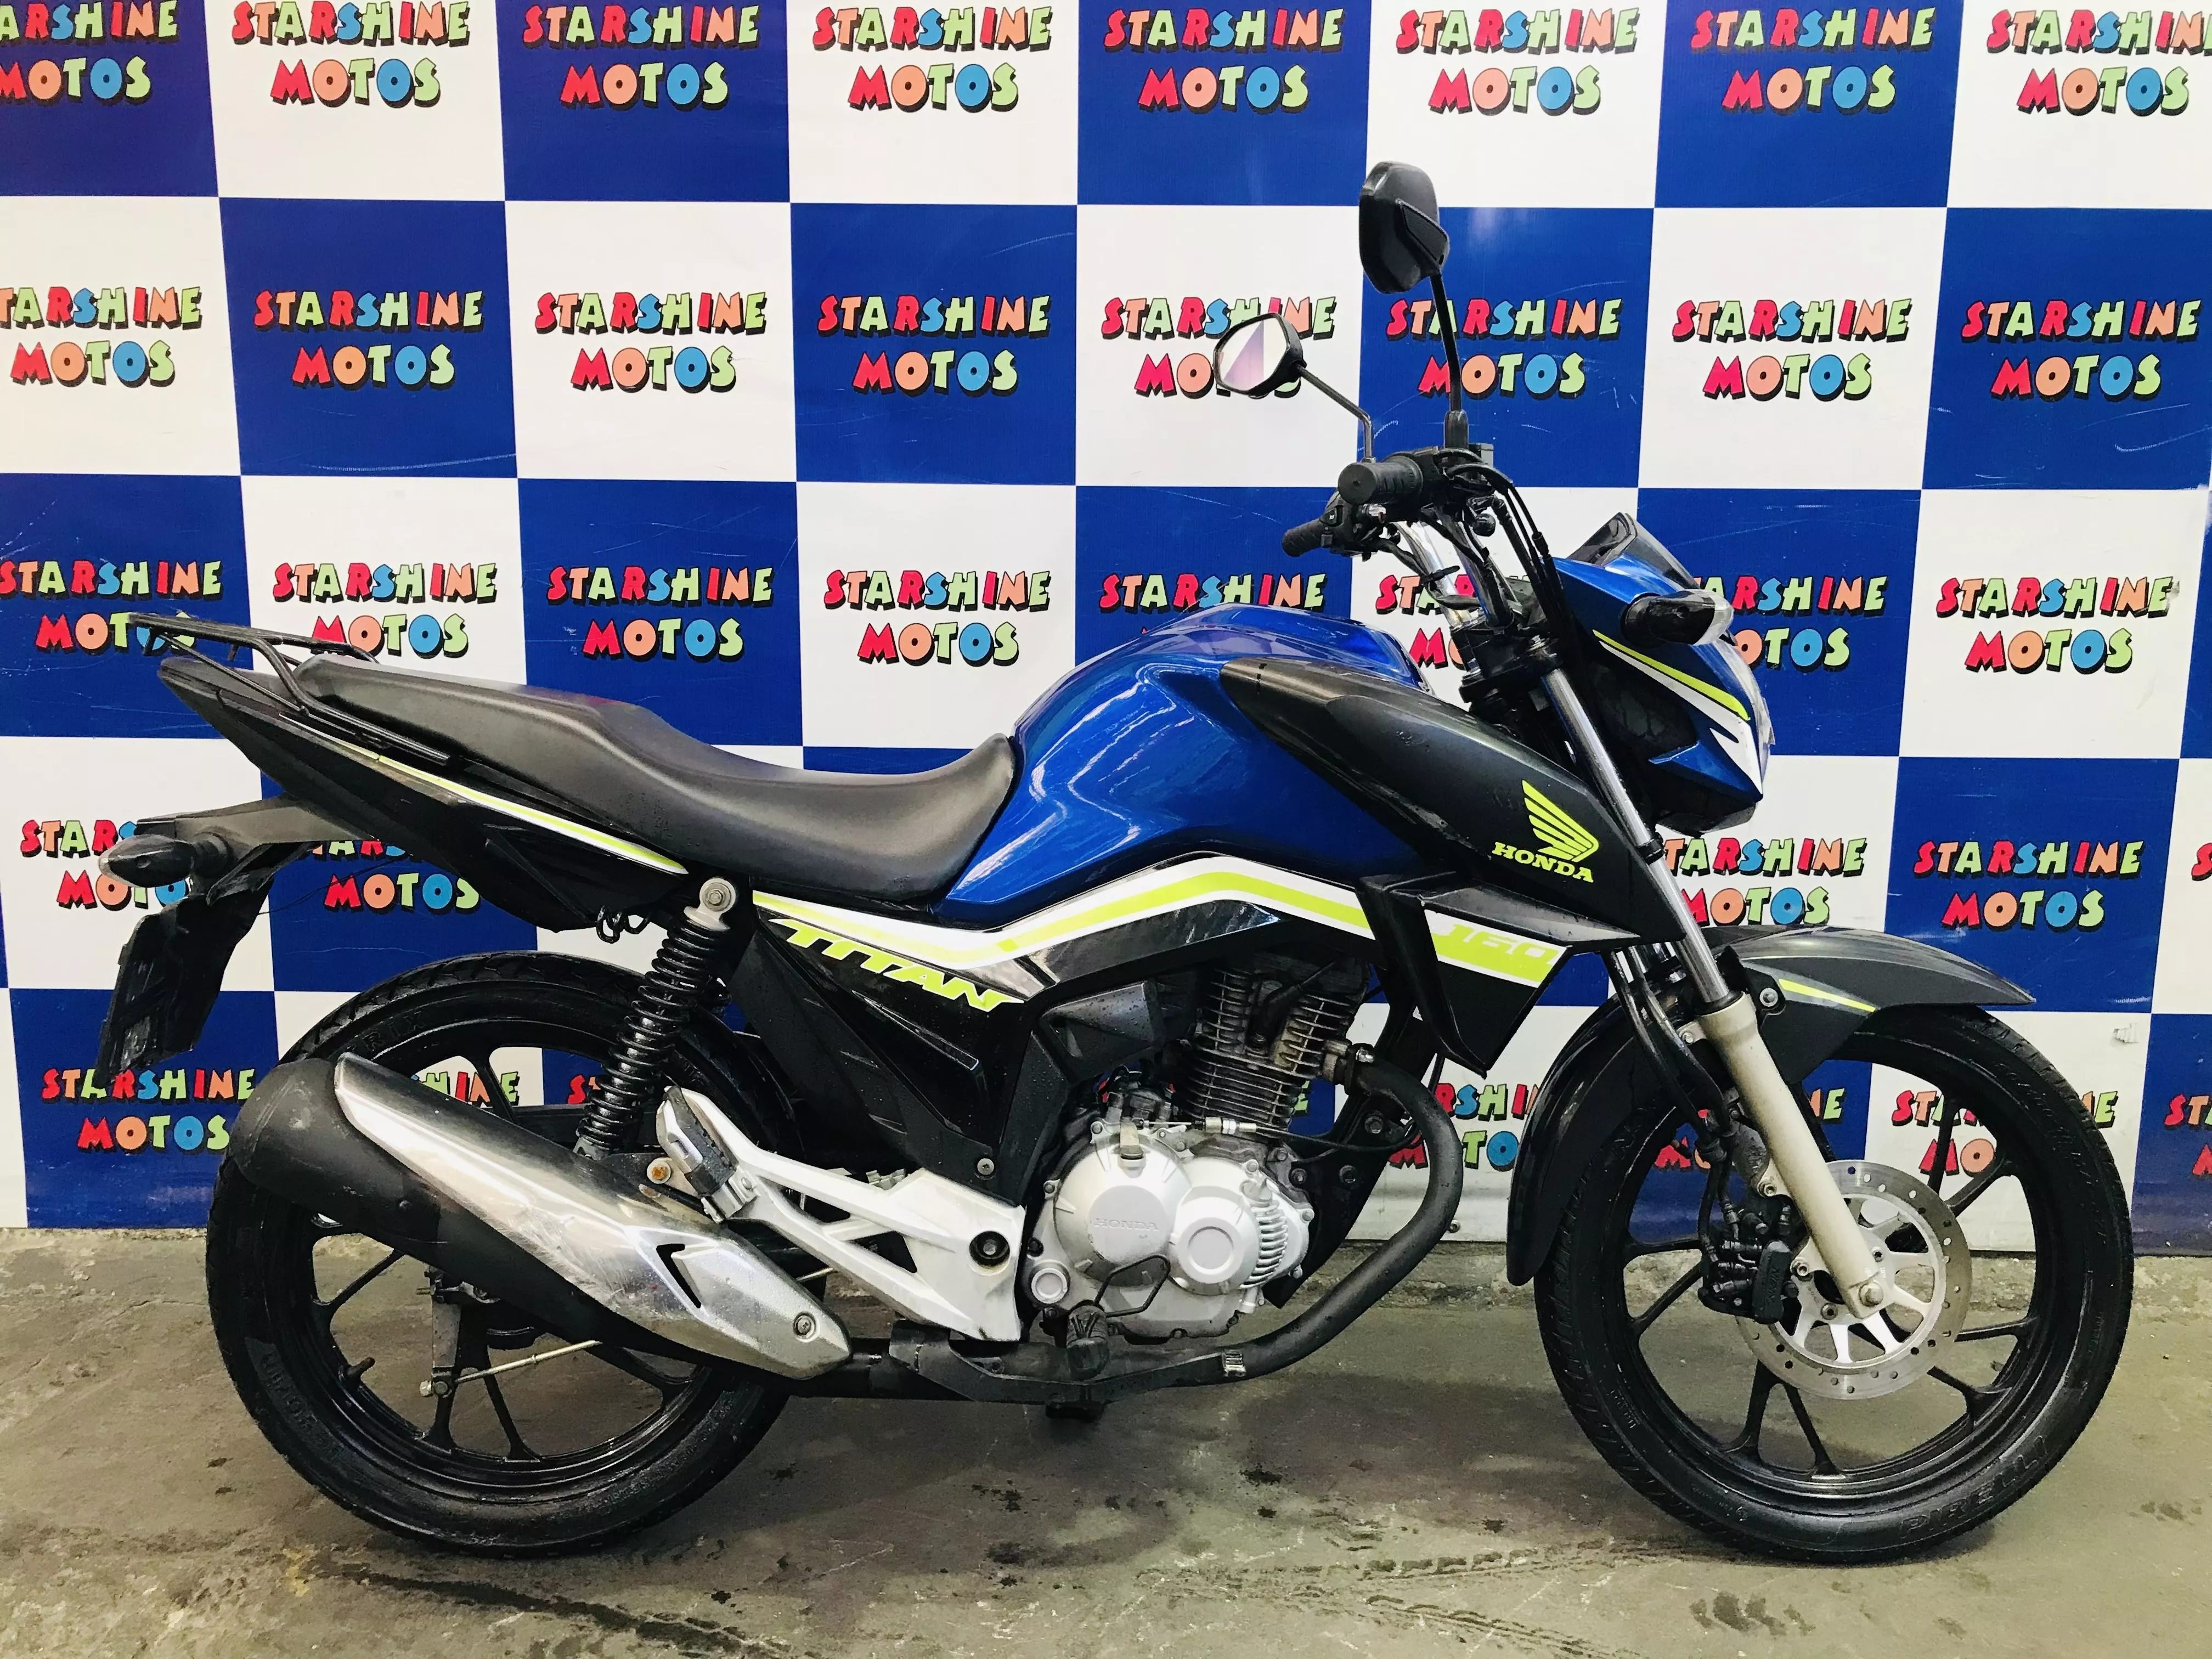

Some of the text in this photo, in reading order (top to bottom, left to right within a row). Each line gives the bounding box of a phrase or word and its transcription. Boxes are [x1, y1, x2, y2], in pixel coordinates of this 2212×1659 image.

[0, 0, 178, 43] ARSHINE
[232, 0, 469, 44] STARSHINE
[523, 4, 759, 47] STARSHINE
[812, 7, 1051, 50] STARSHINE
[1104, 8, 1342, 51] STARSHINE
[1396, 7, 1640, 54] STARSHINE
[1691, 8, 1934, 52] STARSHINE
[0, 56, 151, 104] MOTOS
[270, 58, 441, 105] MOTOS
[560, 63, 728, 109] MOTOS
[848, 63, 1019, 110] MOTOS
[1138, 65, 1308, 112] MOTOS
[1429, 67, 1600, 112] MOTOS
[1722, 65, 1896, 113] MOTOS
[2017, 66, 2191, 114] MOTOS
[0, 285, 201, 328] TARSHINE
[253, 290, 482, 330] STARSHINE
[534, 291, 766, 333] STARSHINE
[817, 295, 1049, 336] STARSHINE
[1672, 299, 1912, 341] STARSHINE
[1961, 300, 2199, 341] STARSHINE
[10, 340, 176, 385] MOTOS
[291, 345, 454, 388] MOTOS
[571, 346, 736, 391] MOTOS
[853, 350, 1018, 396] MOTOS
[1419, 353, 1586, 398] MOTOS
[1703, 353, 1872, 399] MOTOS
[1991, 354, 2162, 400] MOTOS
[0, 560, 222, 599] STARSHINE
[272, 562, 496, 602] STARSHINE
[547, 566, 772, 605] STARSHINE
[823, 570, 1048, 609] STARSHINE
[1099, 573, 1326, 613] STARSHINE
[1692, 576, 1888, 617] ARSHINE
[1936, 577, 2171, 617] STARSHINE
[312, 614, 469, 657] MOTOS
[583, 618, 744, 661] MOTOS
[858, 622, 1019, 665] MOTOS
[1734, 627, 1850, 672] OTOS
[1965, 628, 2134, 673] MOTOS
[1492, 841, 1594, 883] HONDA
[1662, 838, 1866, 878] TARSHINE
[1914, 840, 2143, 878] STARSHINE
[324, 872, 480, 915] MOTOS
[1942, 890, 2105, 932] MOTOS
[768, 918, 1024, 1012] TITAN
[77, 1115, 230, 1153] MOTOS
[1094, 1218, 1159, 1232] HONDA
